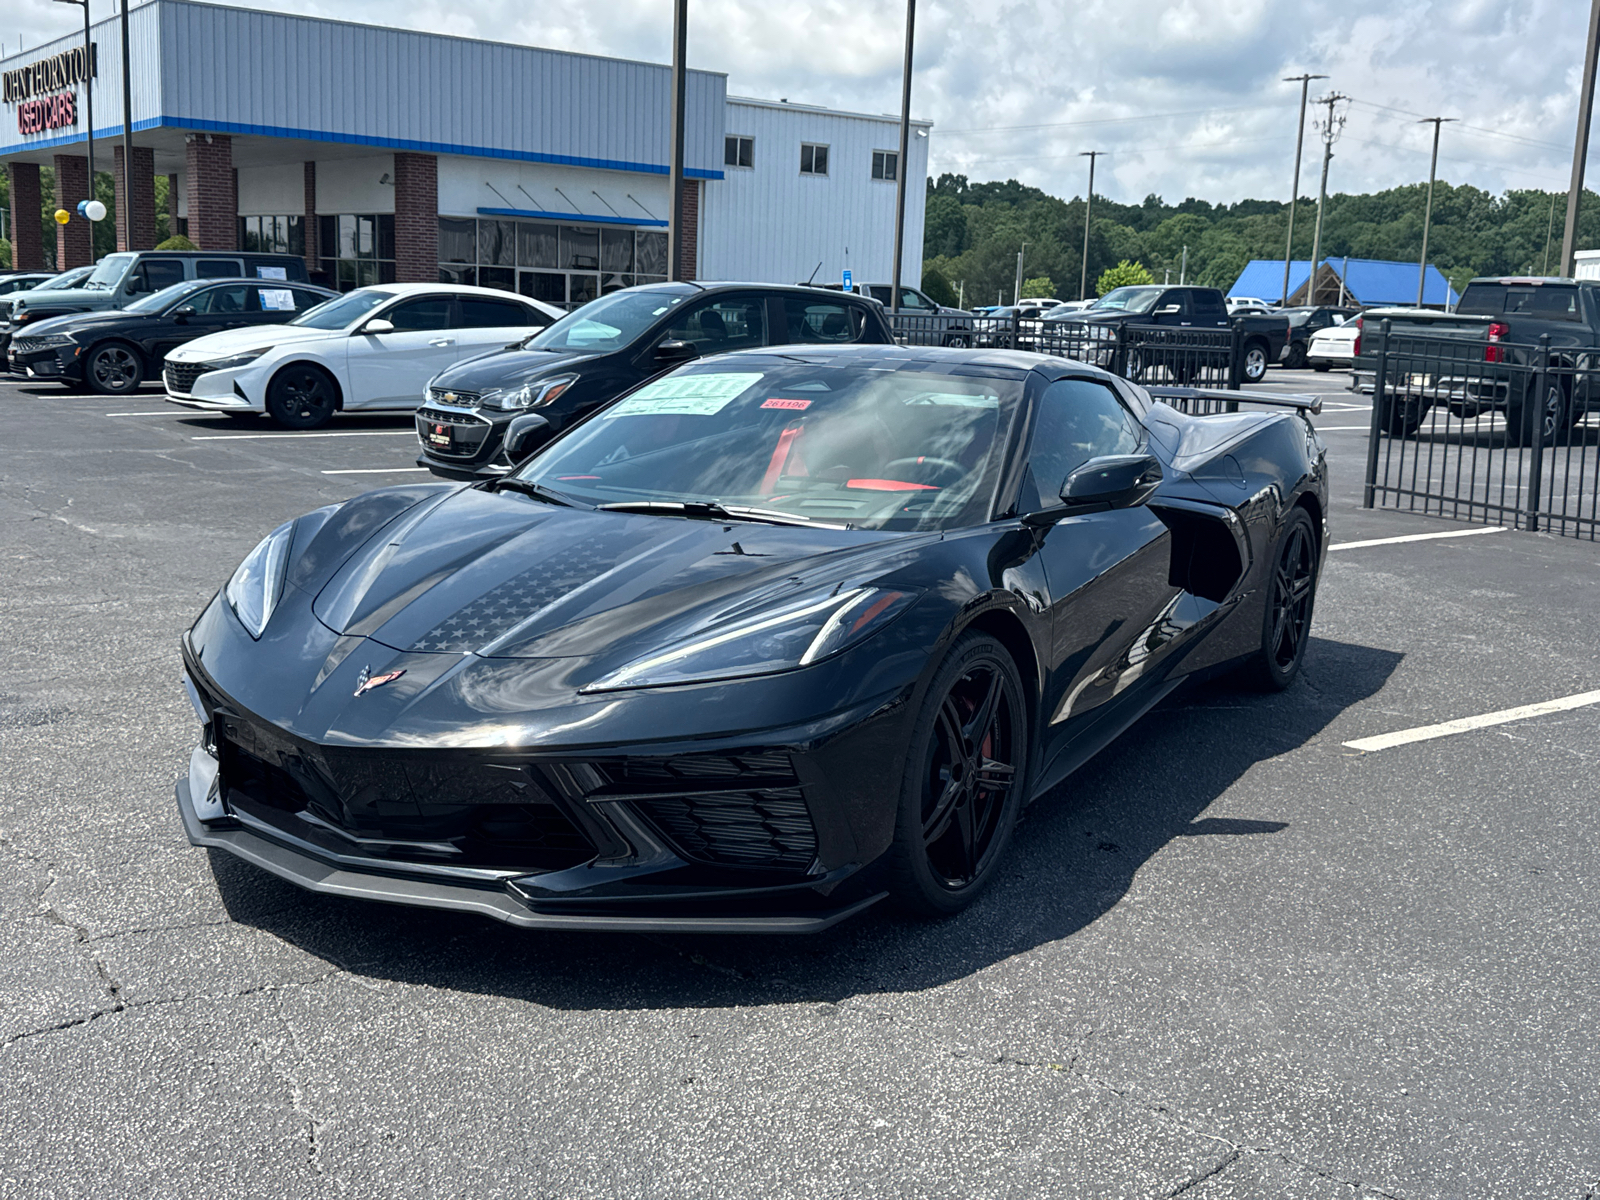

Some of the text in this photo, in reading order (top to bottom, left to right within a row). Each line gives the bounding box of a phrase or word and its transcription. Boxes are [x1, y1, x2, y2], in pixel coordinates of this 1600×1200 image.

[2, 66, 30, 103] JOHN
[17, 91, 75, 134] USED CARS
[764, 400, 807, 409] 261196
